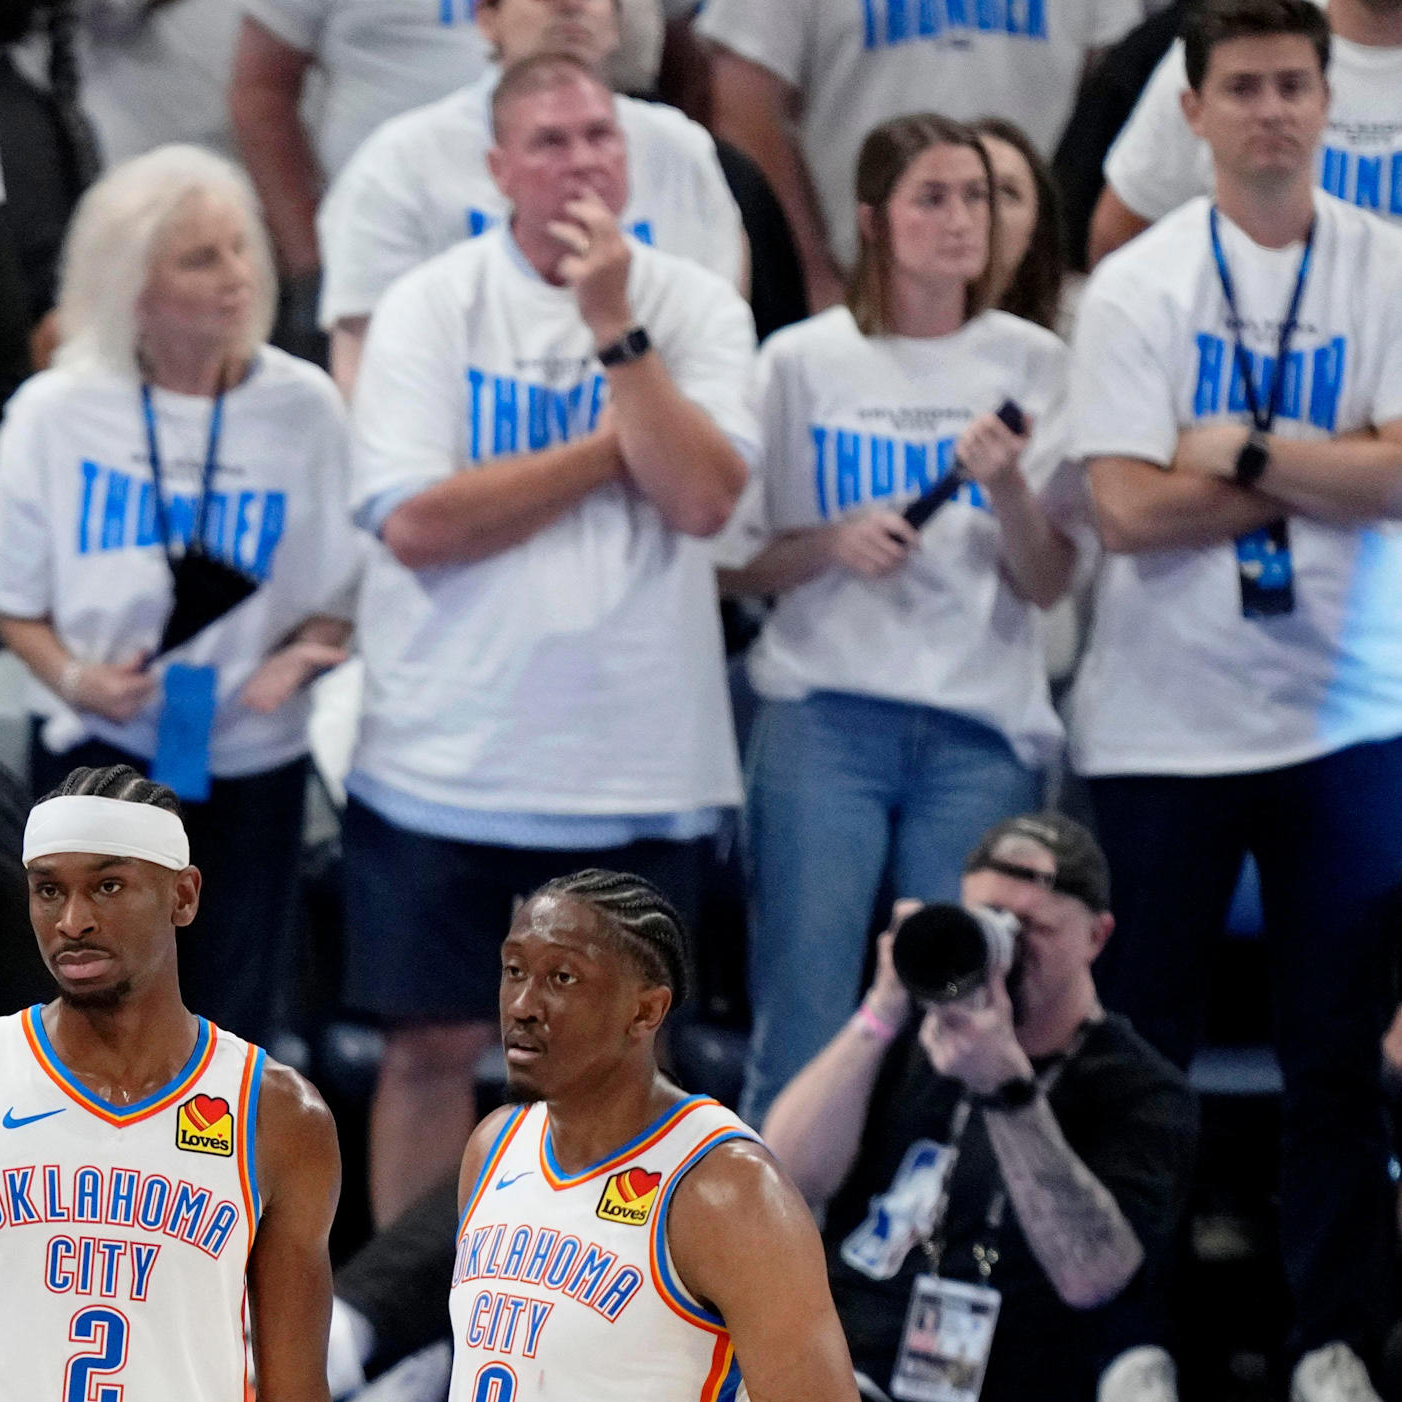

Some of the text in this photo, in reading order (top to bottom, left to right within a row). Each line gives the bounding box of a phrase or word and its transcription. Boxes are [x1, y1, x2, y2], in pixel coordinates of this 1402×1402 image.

[45, 1233, 162, 1302] CITY
[451, 1223, 644, 1324] OKLAHOMA
[465, 1289, 555, 1359] CITY
